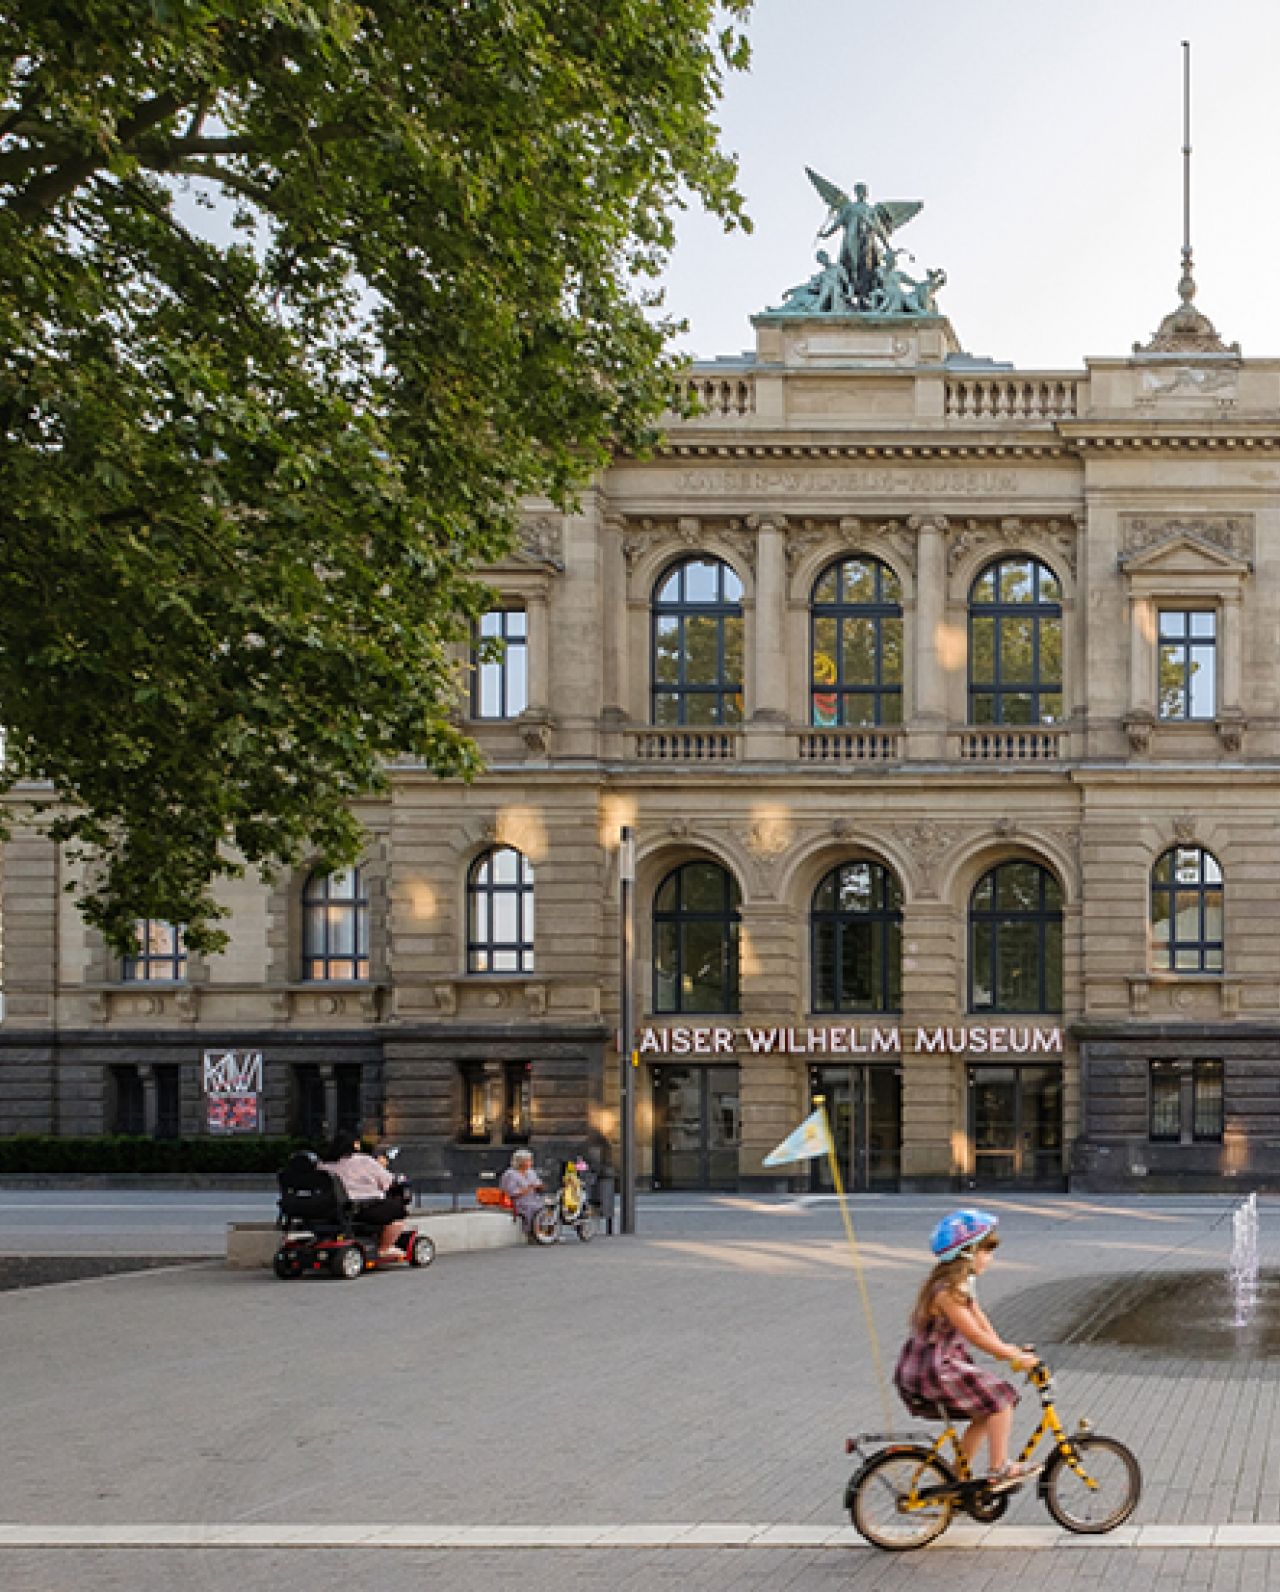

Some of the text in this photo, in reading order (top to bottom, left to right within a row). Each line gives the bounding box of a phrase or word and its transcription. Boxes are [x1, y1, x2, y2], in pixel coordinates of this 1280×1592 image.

[616, 1027, 1063, 1053] AISER WILHELM MUSEUM
